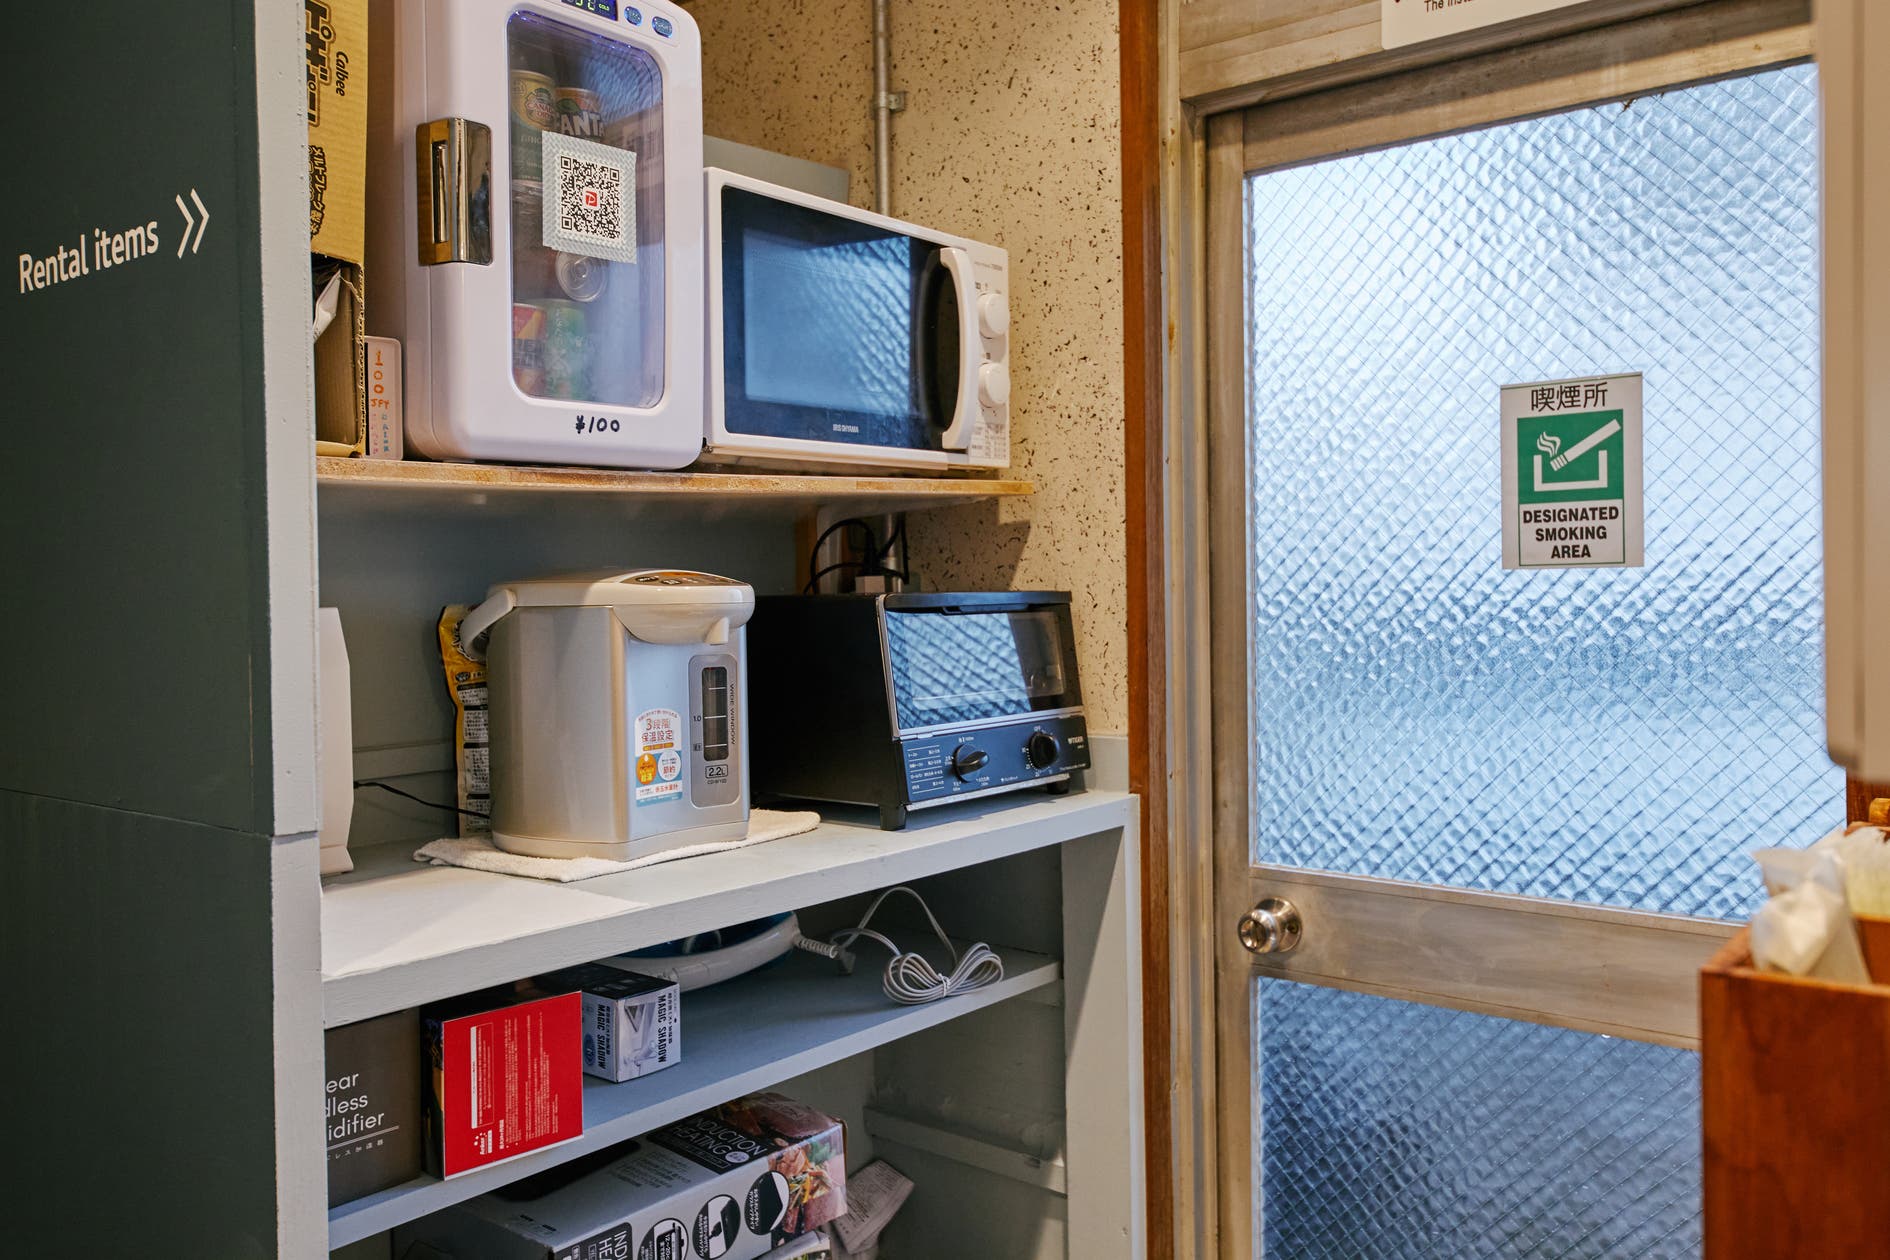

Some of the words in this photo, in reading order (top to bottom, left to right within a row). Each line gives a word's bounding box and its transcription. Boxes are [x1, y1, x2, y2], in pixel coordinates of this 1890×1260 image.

[1424, 0, 1444, 13] The
[336, 51, 349, 97] Calbee
[19, 234, 89, 294] Rental
[94, 221, 159, 271] items
[1531, 382, 1609, 413] 喫煙所
[575, 414, 621, 435] ¥100
[1522, 506, 1620, 524] DESIGNATED
[1535, 526, 1608, 542] SMOKING
[1550, 544, 1592, 559] AREA
[708, 766, 726, 777] 2.2L
[597, 1003, 606, 1031] MAGIC
[597, 1033, 607, 1070] SHADOW
[657, 1026, 667, 1064] SHADOW
[598, 1237, 613, 1260] HE
[614, 1230, 628, 1260] IND
